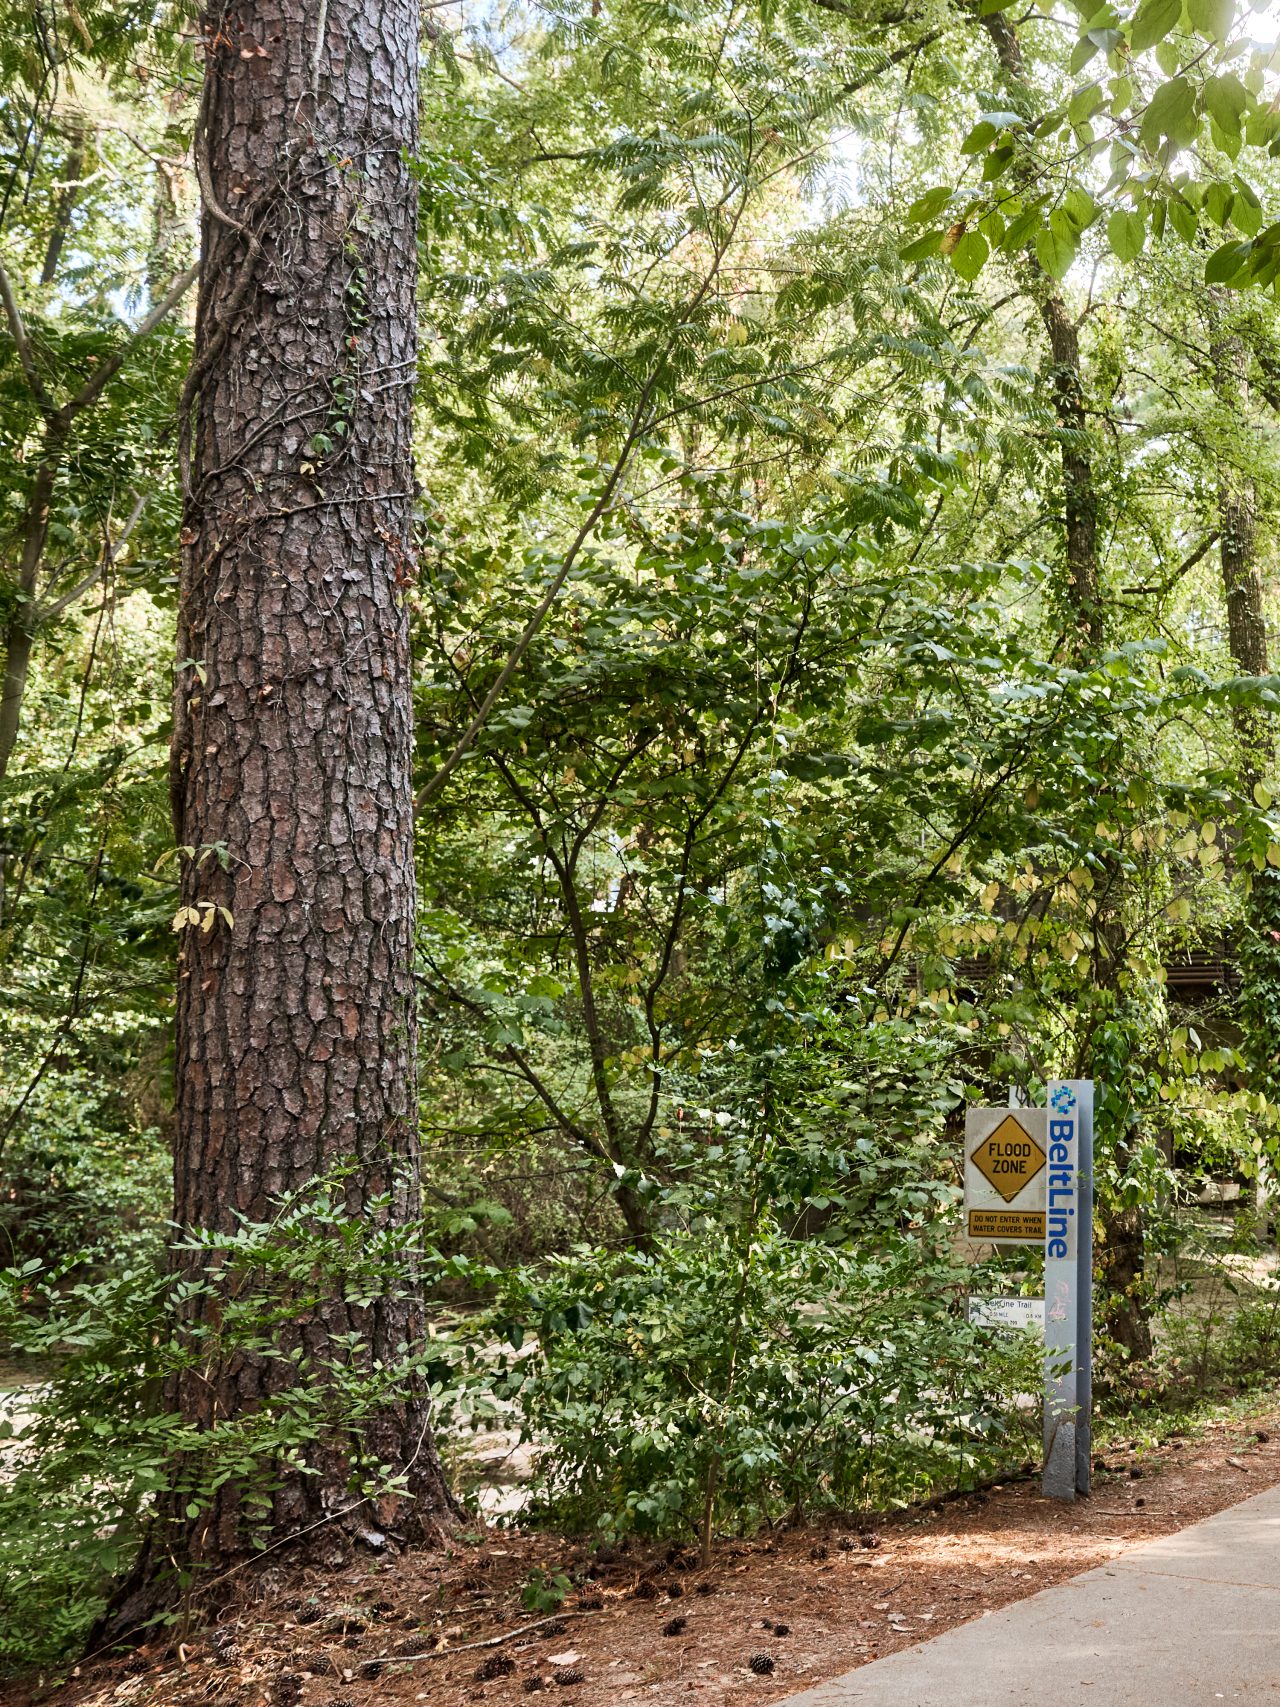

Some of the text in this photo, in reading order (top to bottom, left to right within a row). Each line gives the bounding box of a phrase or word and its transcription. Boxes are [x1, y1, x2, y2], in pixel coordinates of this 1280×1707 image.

[989, 1143, 1031, 1157] FLOOD
[992, 1160, 1027, 1174] ZONE
[1049, 1120, 1074, 1259] BeltLine
[985, 1215, 998, 1223] NOT
[999, 1216, 1020, 1224] ENTER
[1022, 1216, 1042, 1224] WHEN
[973, 1224, 1043, 1234] WATER COVERS TRAIL
[1018, 1300, 1032, 1309] Trail
